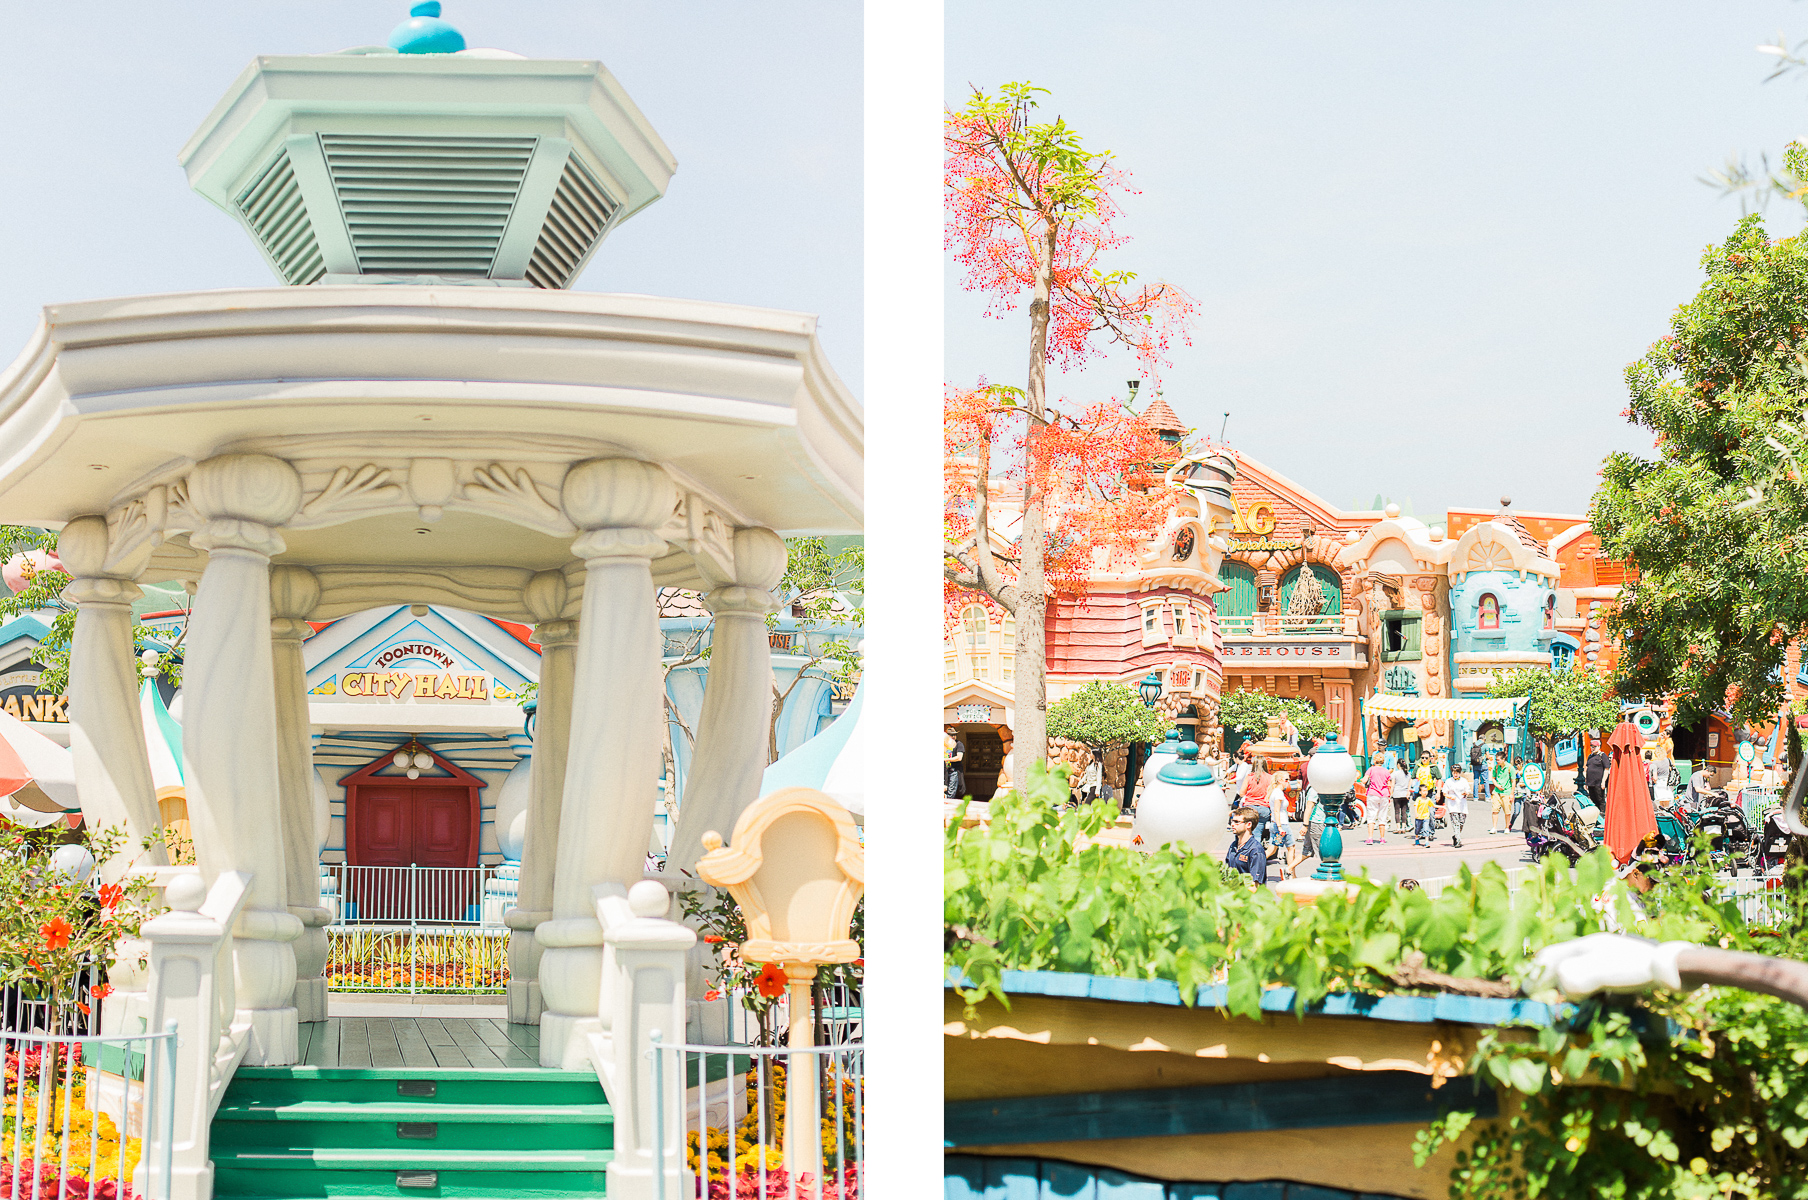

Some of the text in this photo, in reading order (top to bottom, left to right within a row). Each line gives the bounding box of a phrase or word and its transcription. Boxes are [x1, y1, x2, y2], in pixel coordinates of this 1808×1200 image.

[1208, 493, 1276, 535] AG
[375, 645, 454, 669] TOONTOWN
[1221, 647, 1340, 656] REHOUSE
[1385, 666, 1418, 690] SAFE
[1458, 667, 1532, 675] INSURAN
[342, 672, 487, 700] CITY HALL
[0, 694, 69, 722] ANK
